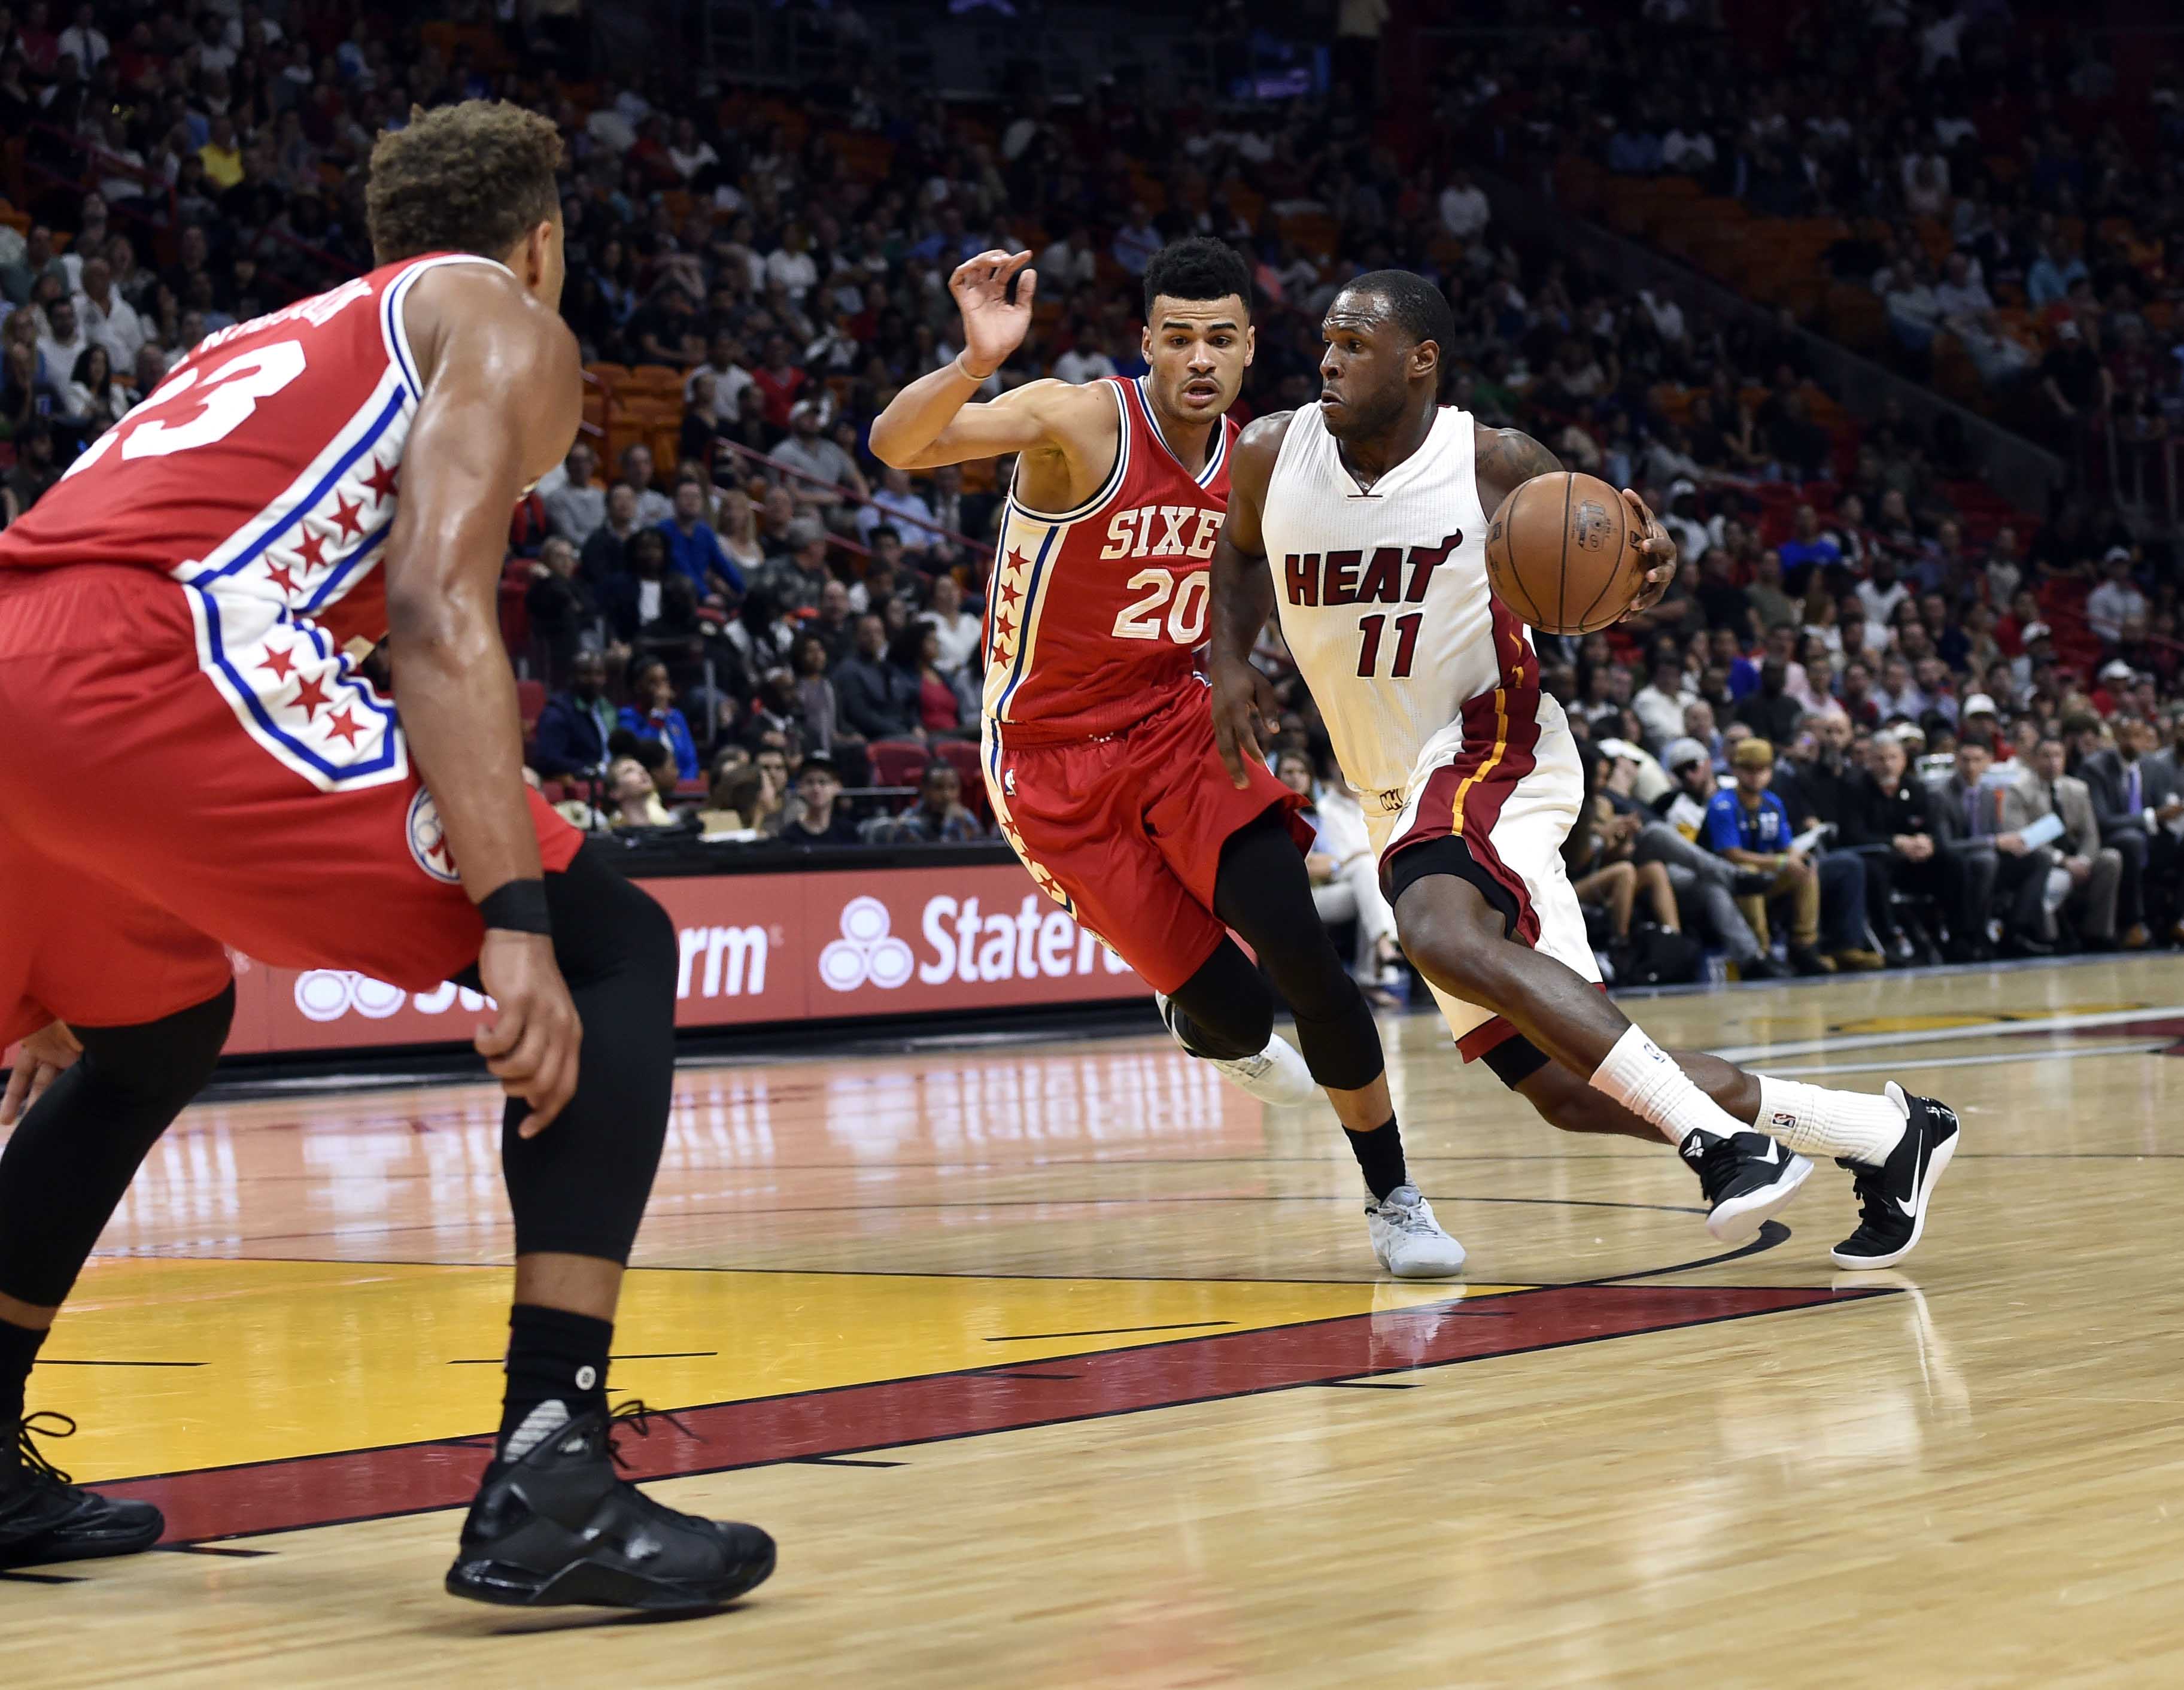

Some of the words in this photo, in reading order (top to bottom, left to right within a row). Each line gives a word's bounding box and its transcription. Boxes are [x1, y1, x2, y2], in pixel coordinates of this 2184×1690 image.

[1099, 504, 1226, 561] SIXE
[1284, 528, 1463, 607] HEAT
[1111, 568, 1211, 645] 20
[1355, 612, 1424, 679] 11
[676, 925, 768, 1000] rm
